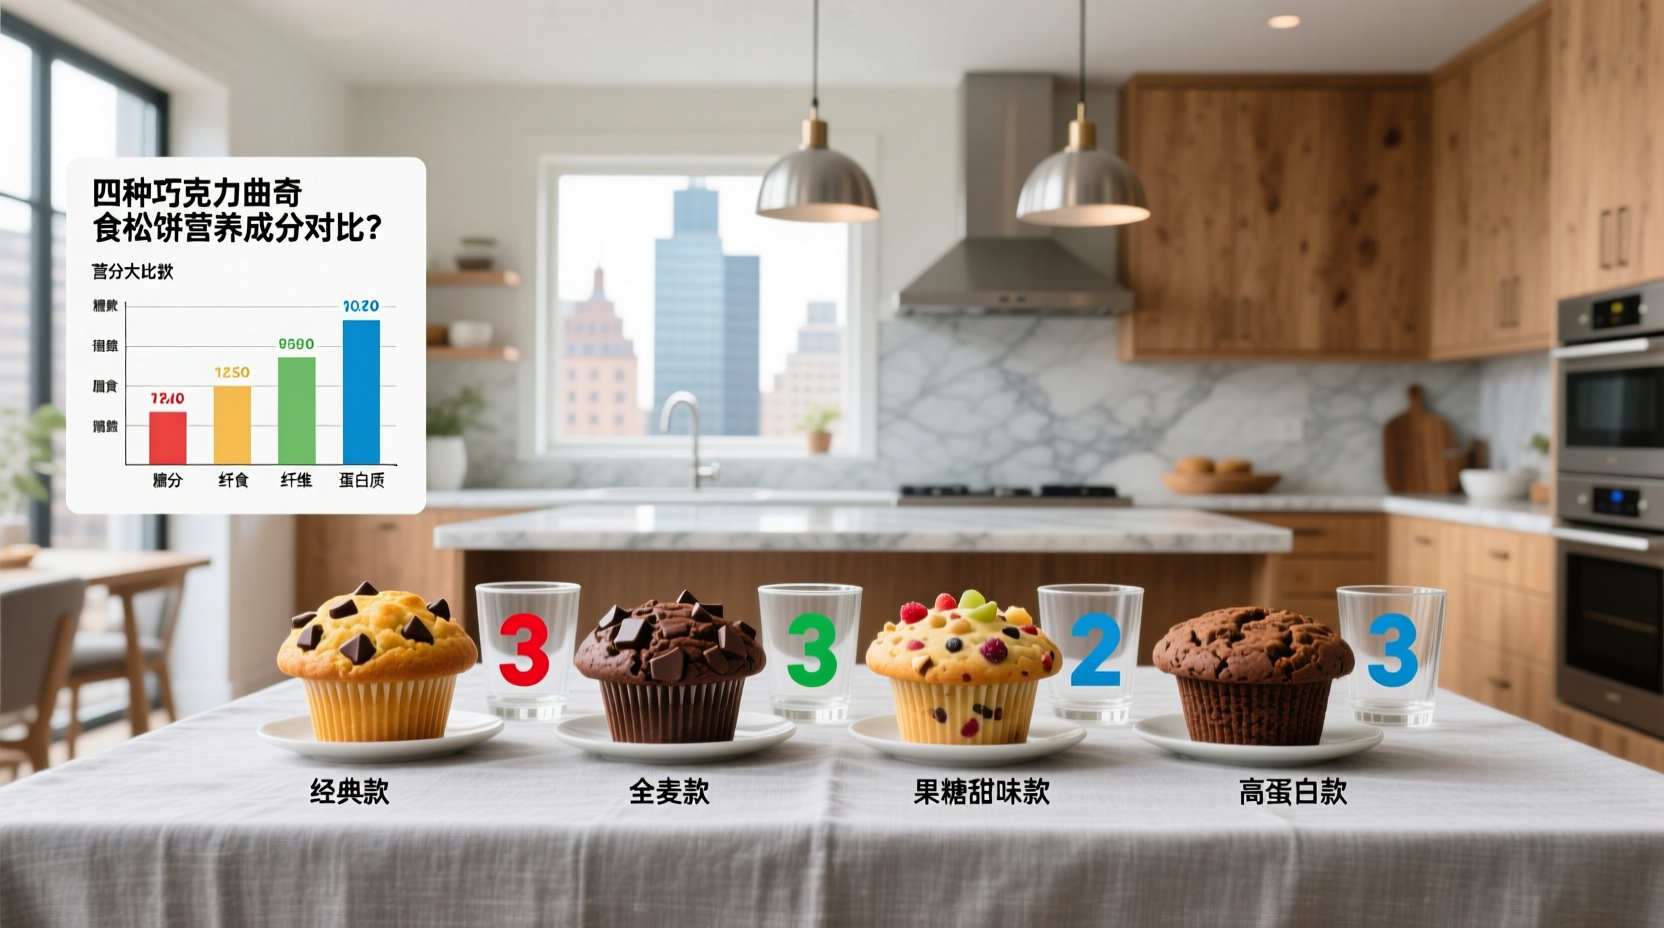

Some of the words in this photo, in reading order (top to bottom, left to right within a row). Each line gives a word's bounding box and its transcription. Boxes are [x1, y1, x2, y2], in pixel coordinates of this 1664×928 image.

[499, 612, 550, 687] 3
[787, 613, 837, 688] 3
[1070, 612, 1121, 687] 2
[1368, 613, 1418, 688] 3
